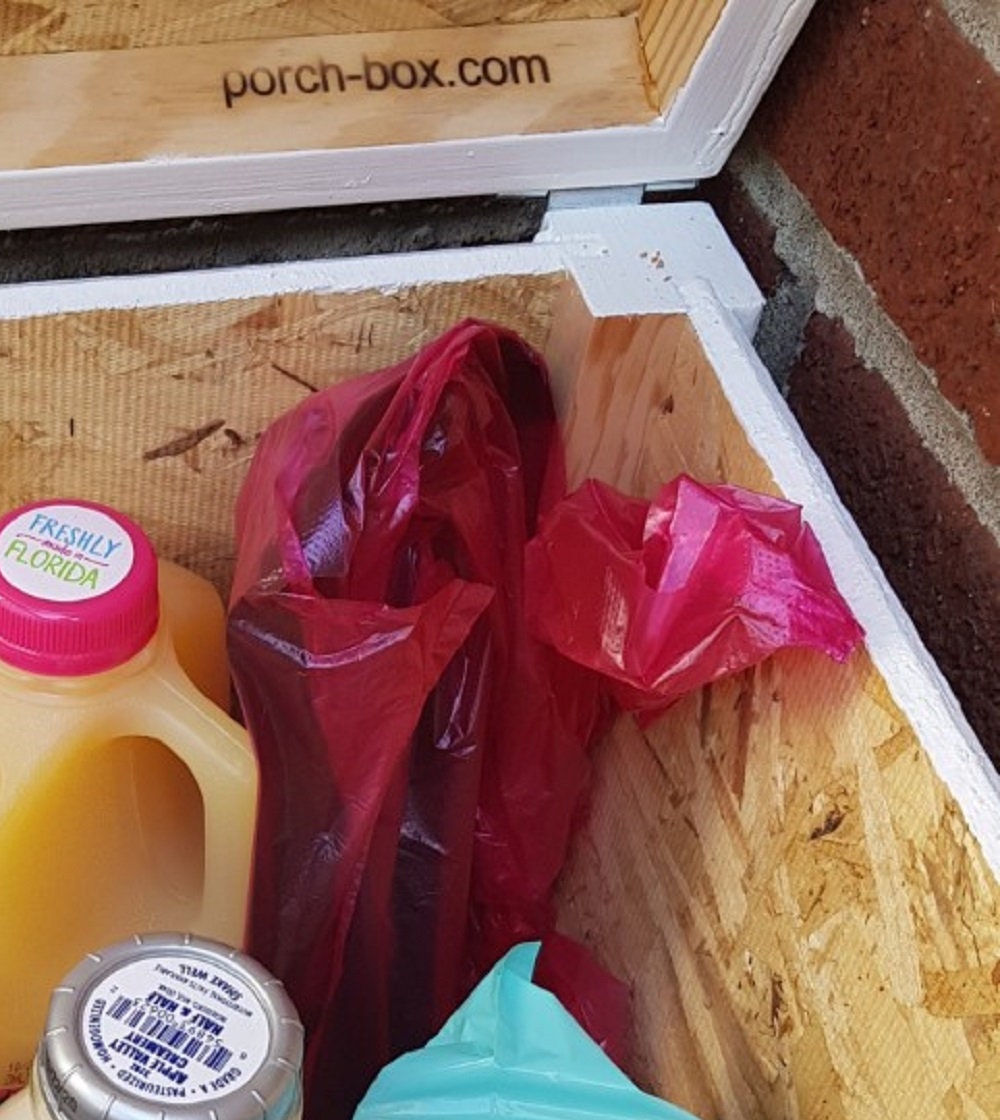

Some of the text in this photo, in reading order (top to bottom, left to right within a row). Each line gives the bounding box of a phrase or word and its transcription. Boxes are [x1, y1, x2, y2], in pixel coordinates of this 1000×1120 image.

[222, 52, 551, 108] porch-box.com
[28, 513, 122, 559] FRESHLY
[4, 539, 100, 590] FLORIDA
[145, 990, 224, 1036] HALF & HALF
[108, 1038, 188, 1084] APPLE VALLEY
[122, 1030, 188, 1069] CREAMERY
[116, 1069, 185, 1097] PASTEURIZED
[199, 1083, 207, 1093] A
[209, 1067, 240, 1090] GRADE
